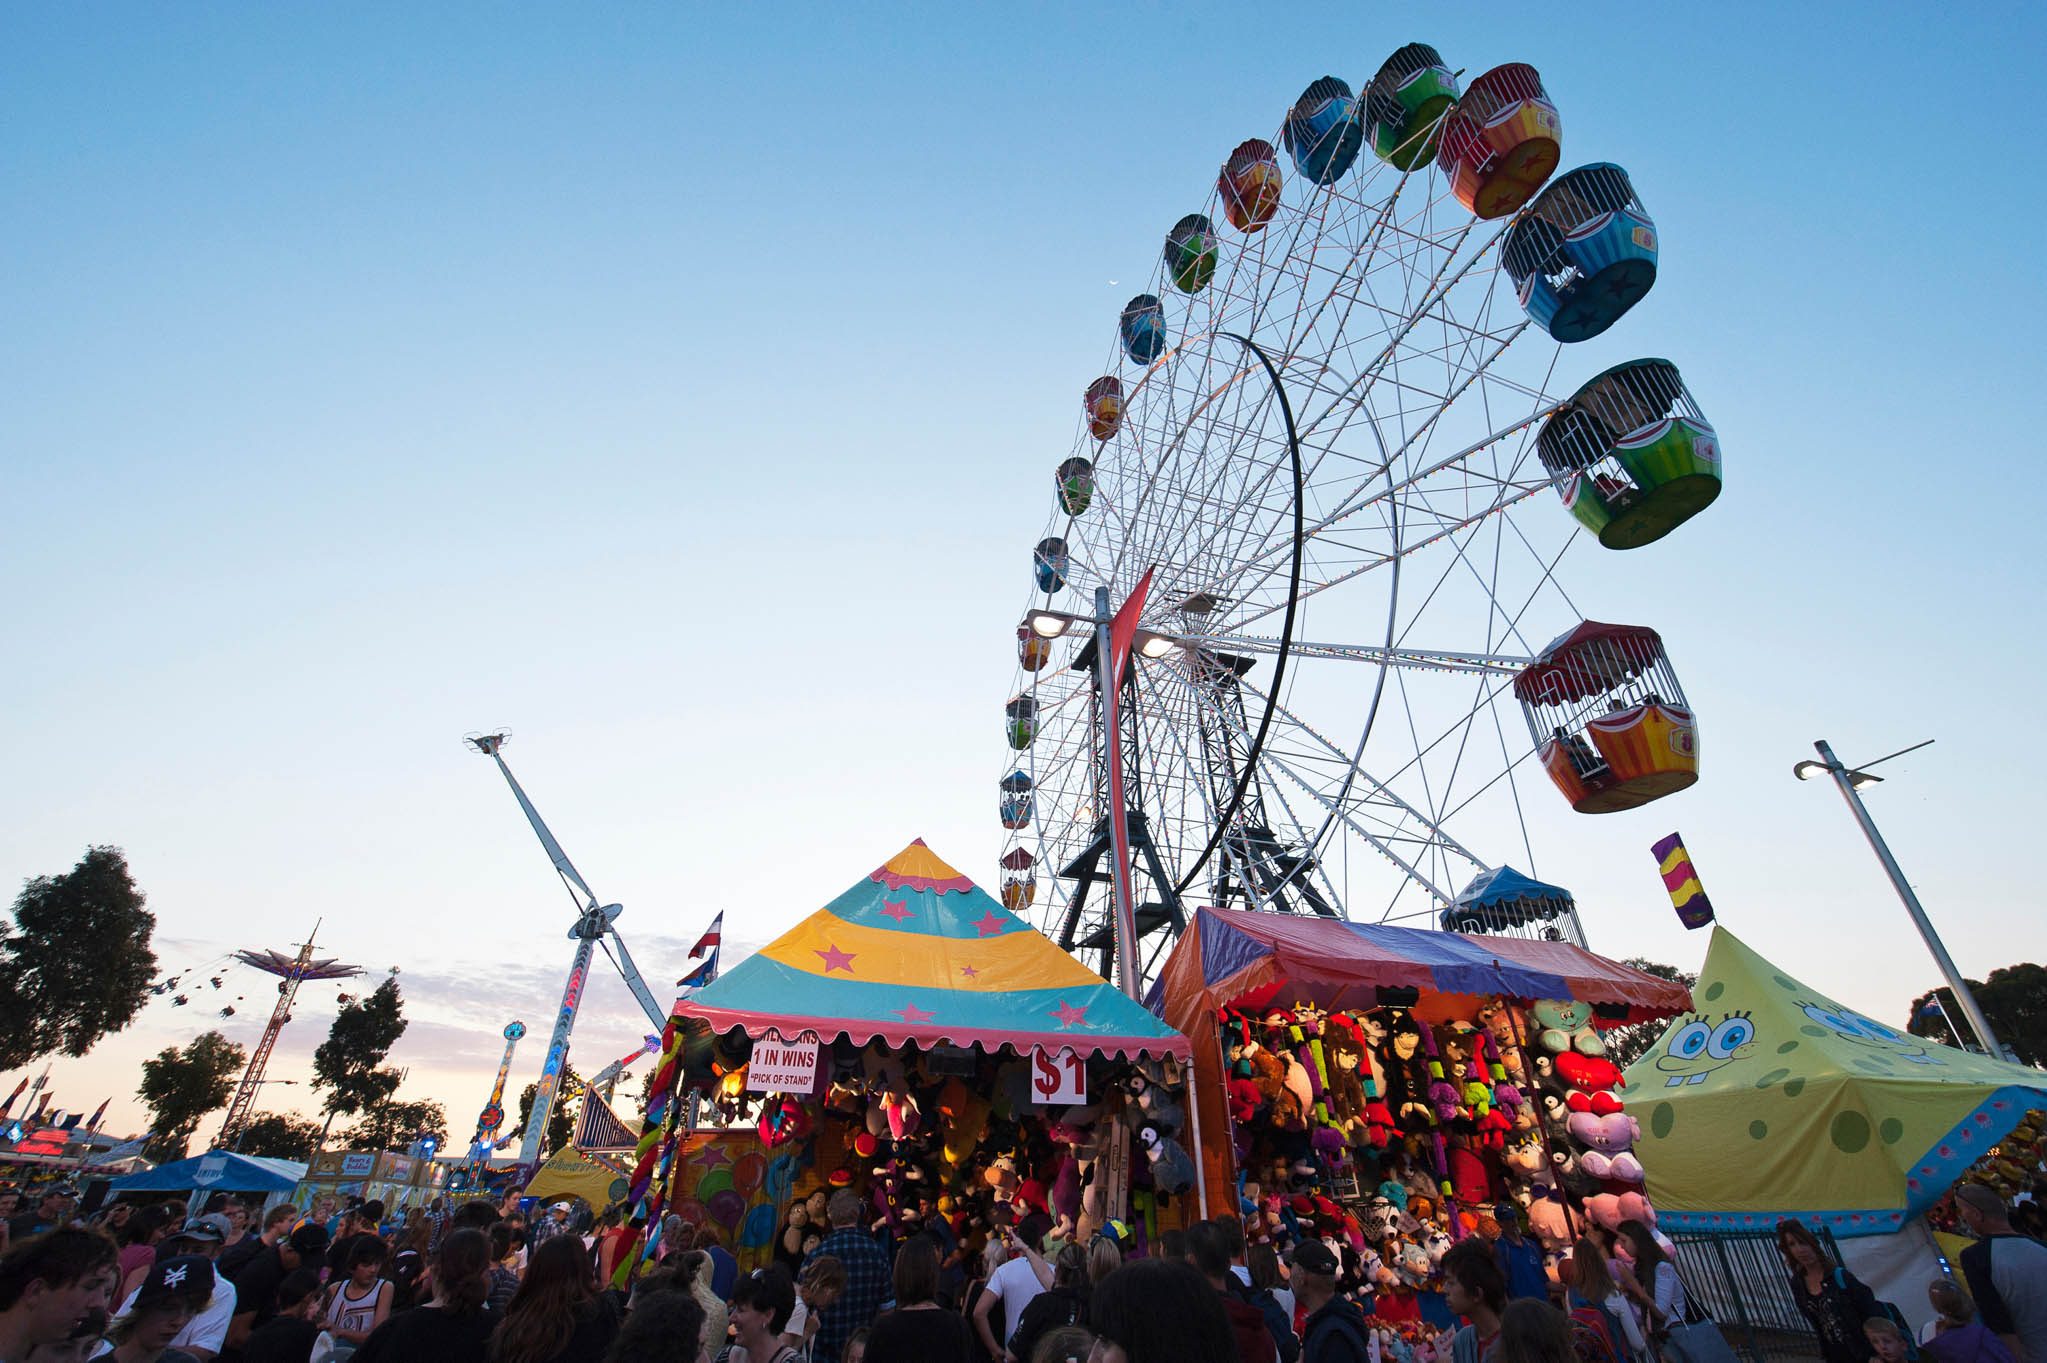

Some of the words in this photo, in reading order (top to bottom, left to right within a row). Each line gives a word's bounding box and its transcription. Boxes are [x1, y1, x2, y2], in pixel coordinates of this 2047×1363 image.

[754, 1048, 760, 1065] 1
[764, 1049, 779, 1065] IN
[782, 1050, 815, 1068] WINS
[773, 1074, 783, 1084] OF
[1035, 1046, 1084, 1101] $1
